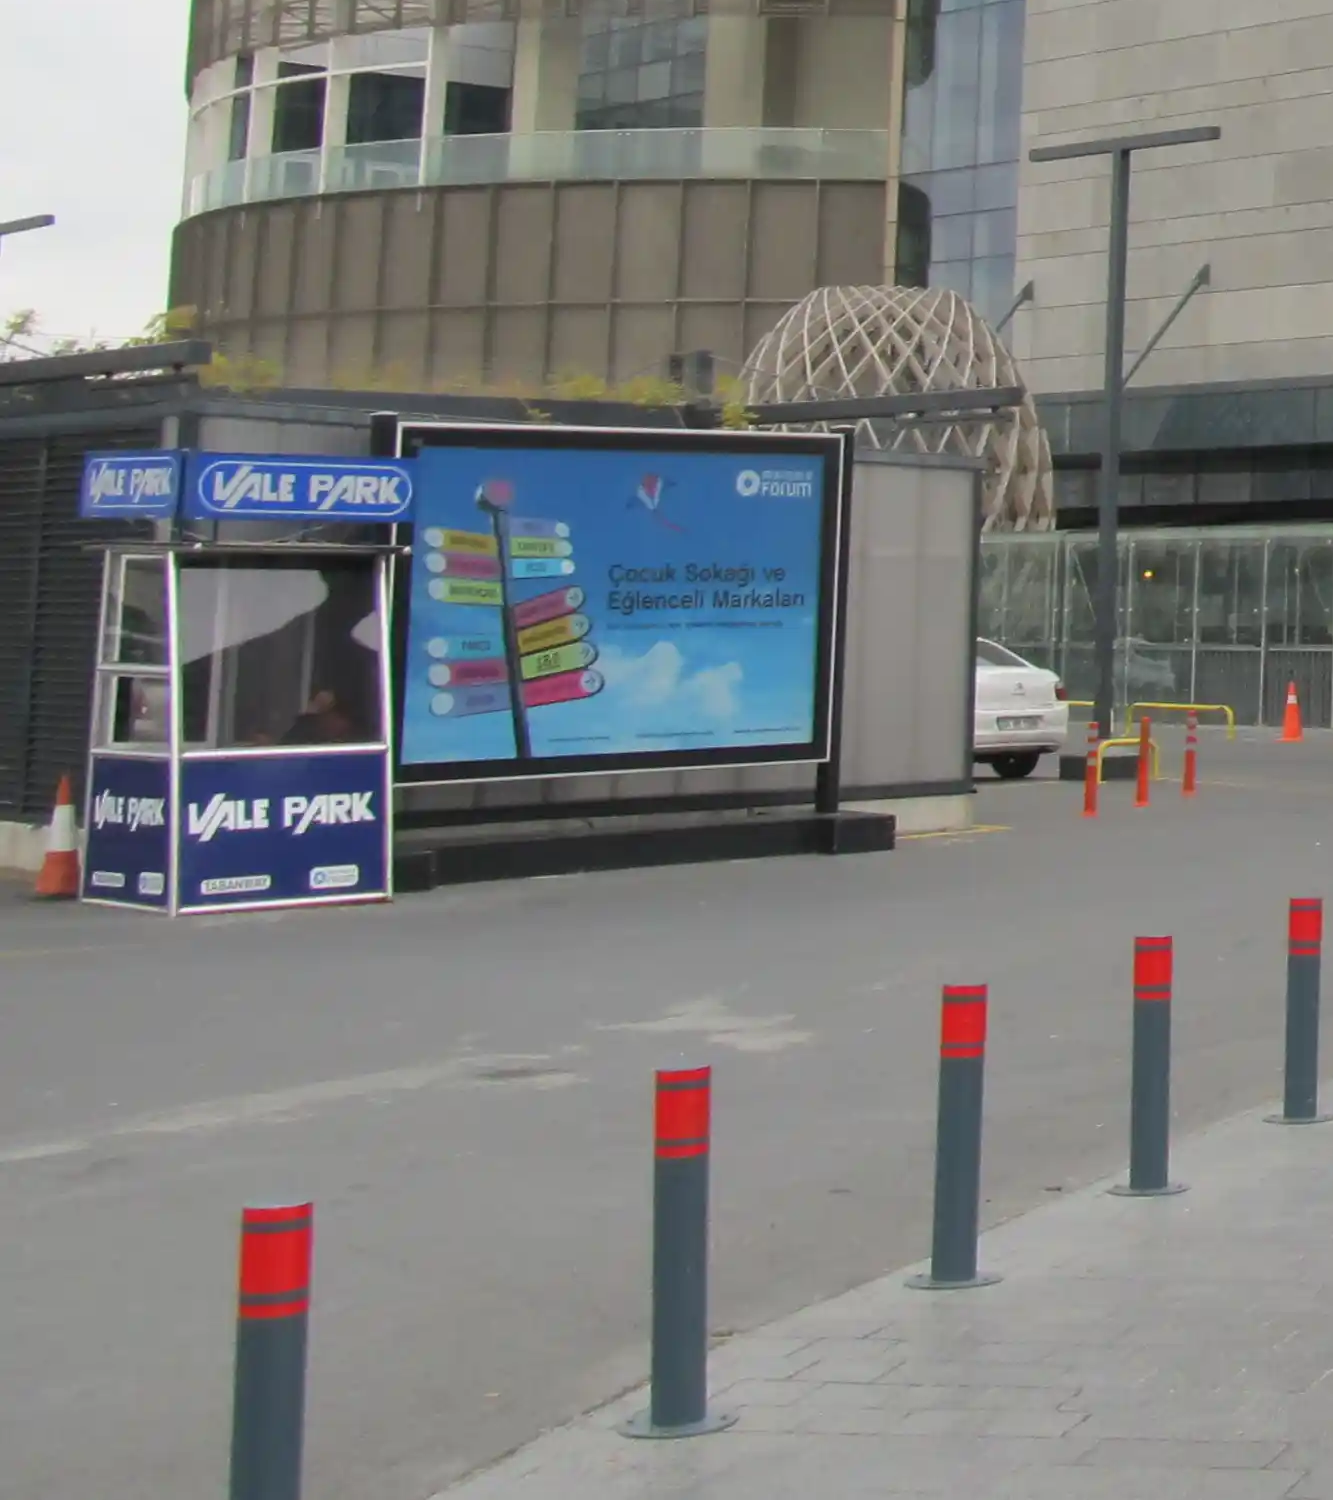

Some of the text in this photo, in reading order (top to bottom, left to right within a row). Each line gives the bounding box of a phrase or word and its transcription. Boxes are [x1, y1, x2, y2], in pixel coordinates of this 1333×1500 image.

[90, 462, 172, 504] VALE PARK
[212, 465, 401, 510] VALE PARK
[608, 564, 676, 588] Çocuk
[763, 565, 786, 582] ve
[608, 588, 704, 615] Eğlenceli
[93, 789, 166, 831] VALE PARK
[188, 792, 376, 842] VALE PARK
